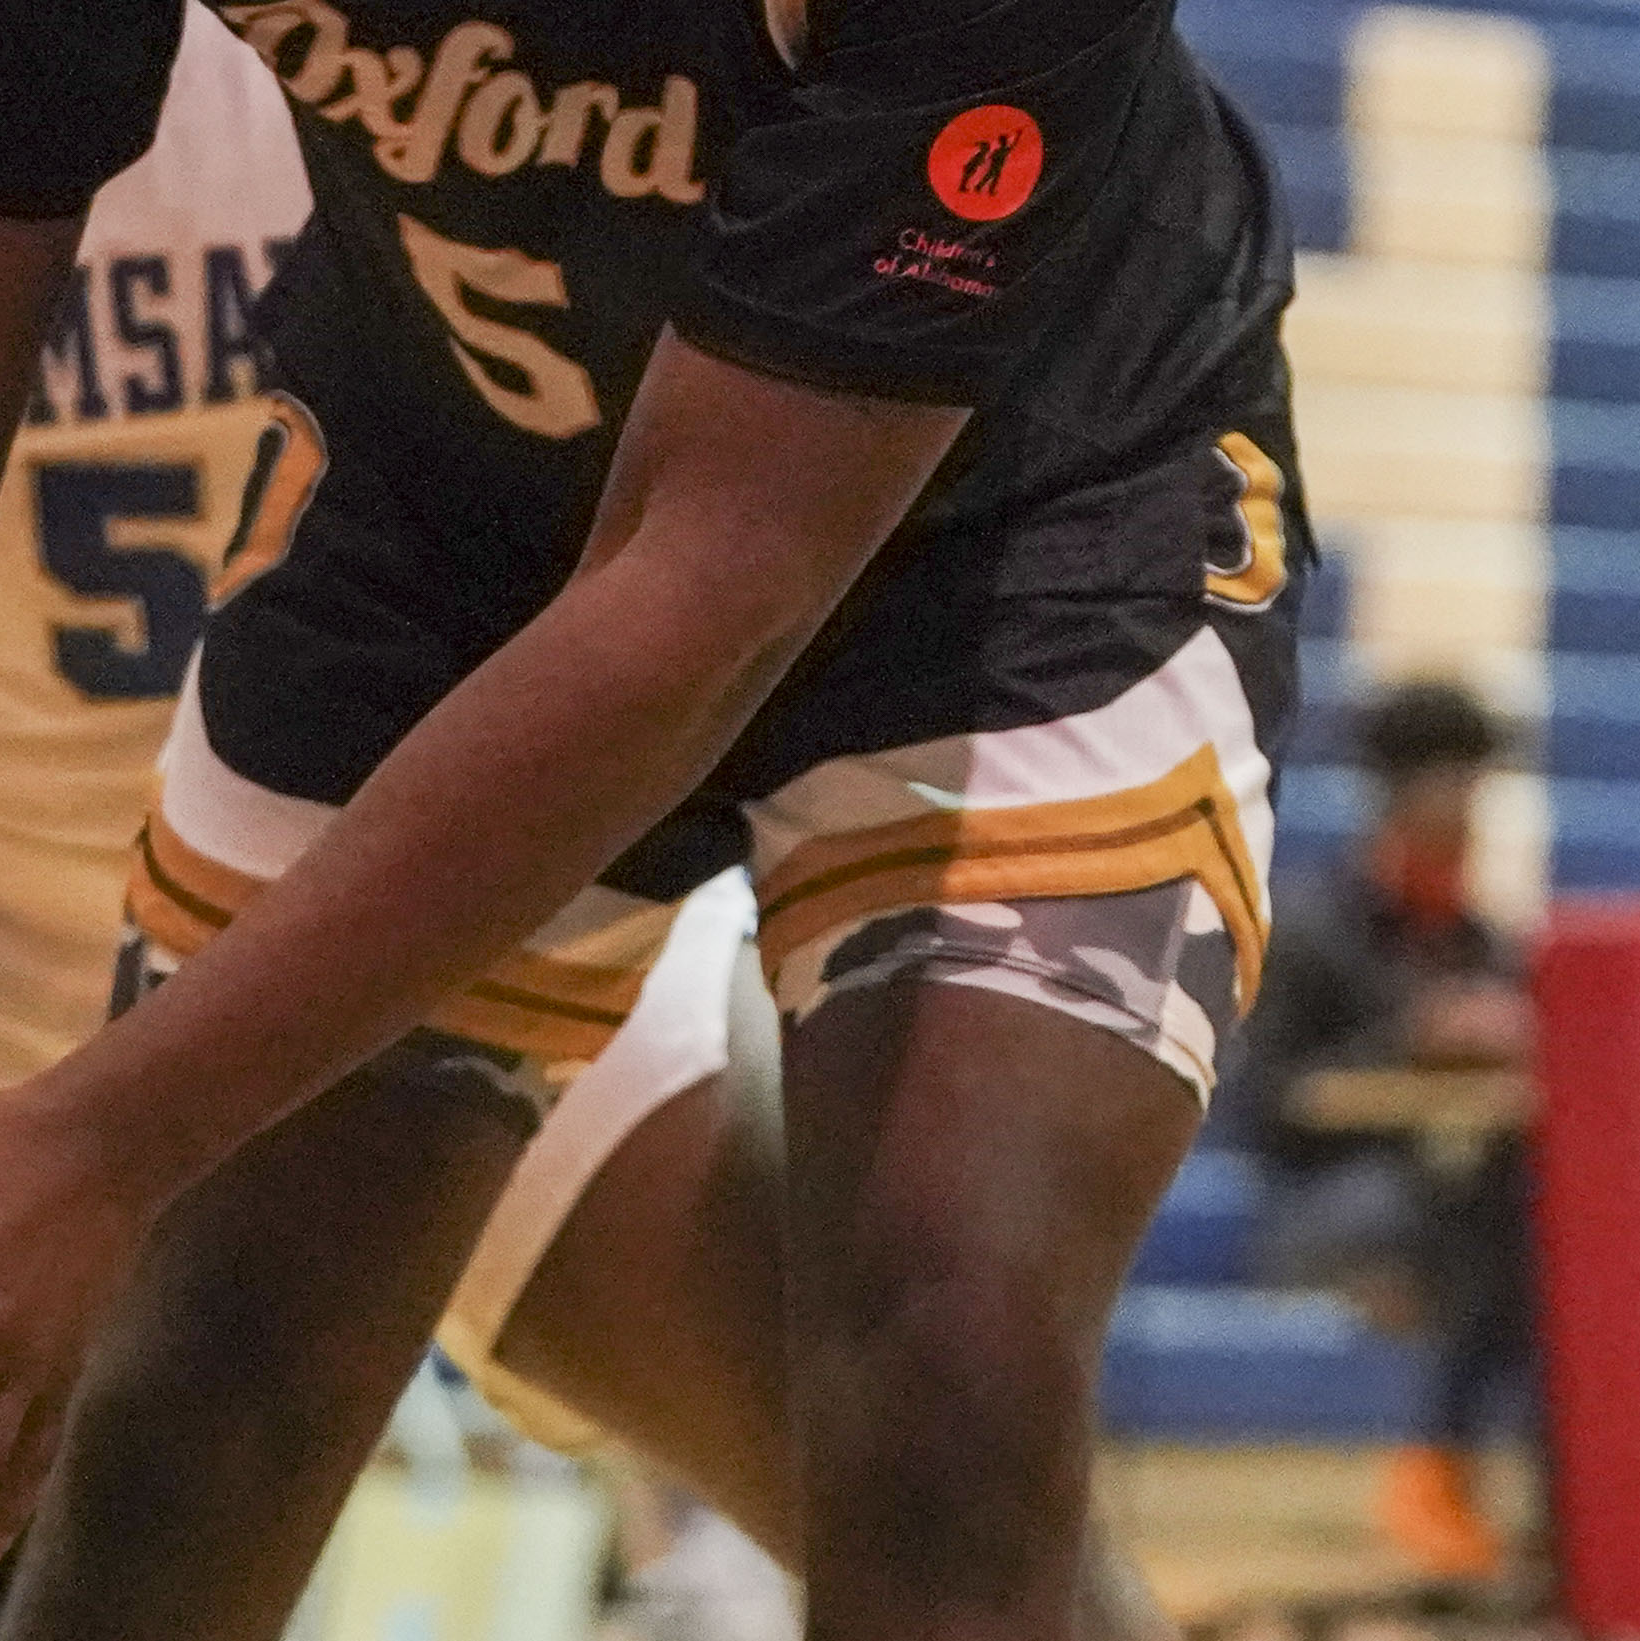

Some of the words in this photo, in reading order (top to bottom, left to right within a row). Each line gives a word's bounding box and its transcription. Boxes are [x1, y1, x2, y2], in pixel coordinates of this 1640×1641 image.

[23, 237, 296, 427] MSA
[397, 211, 602, 441] 5
[27, 456, 212, 702] 5
